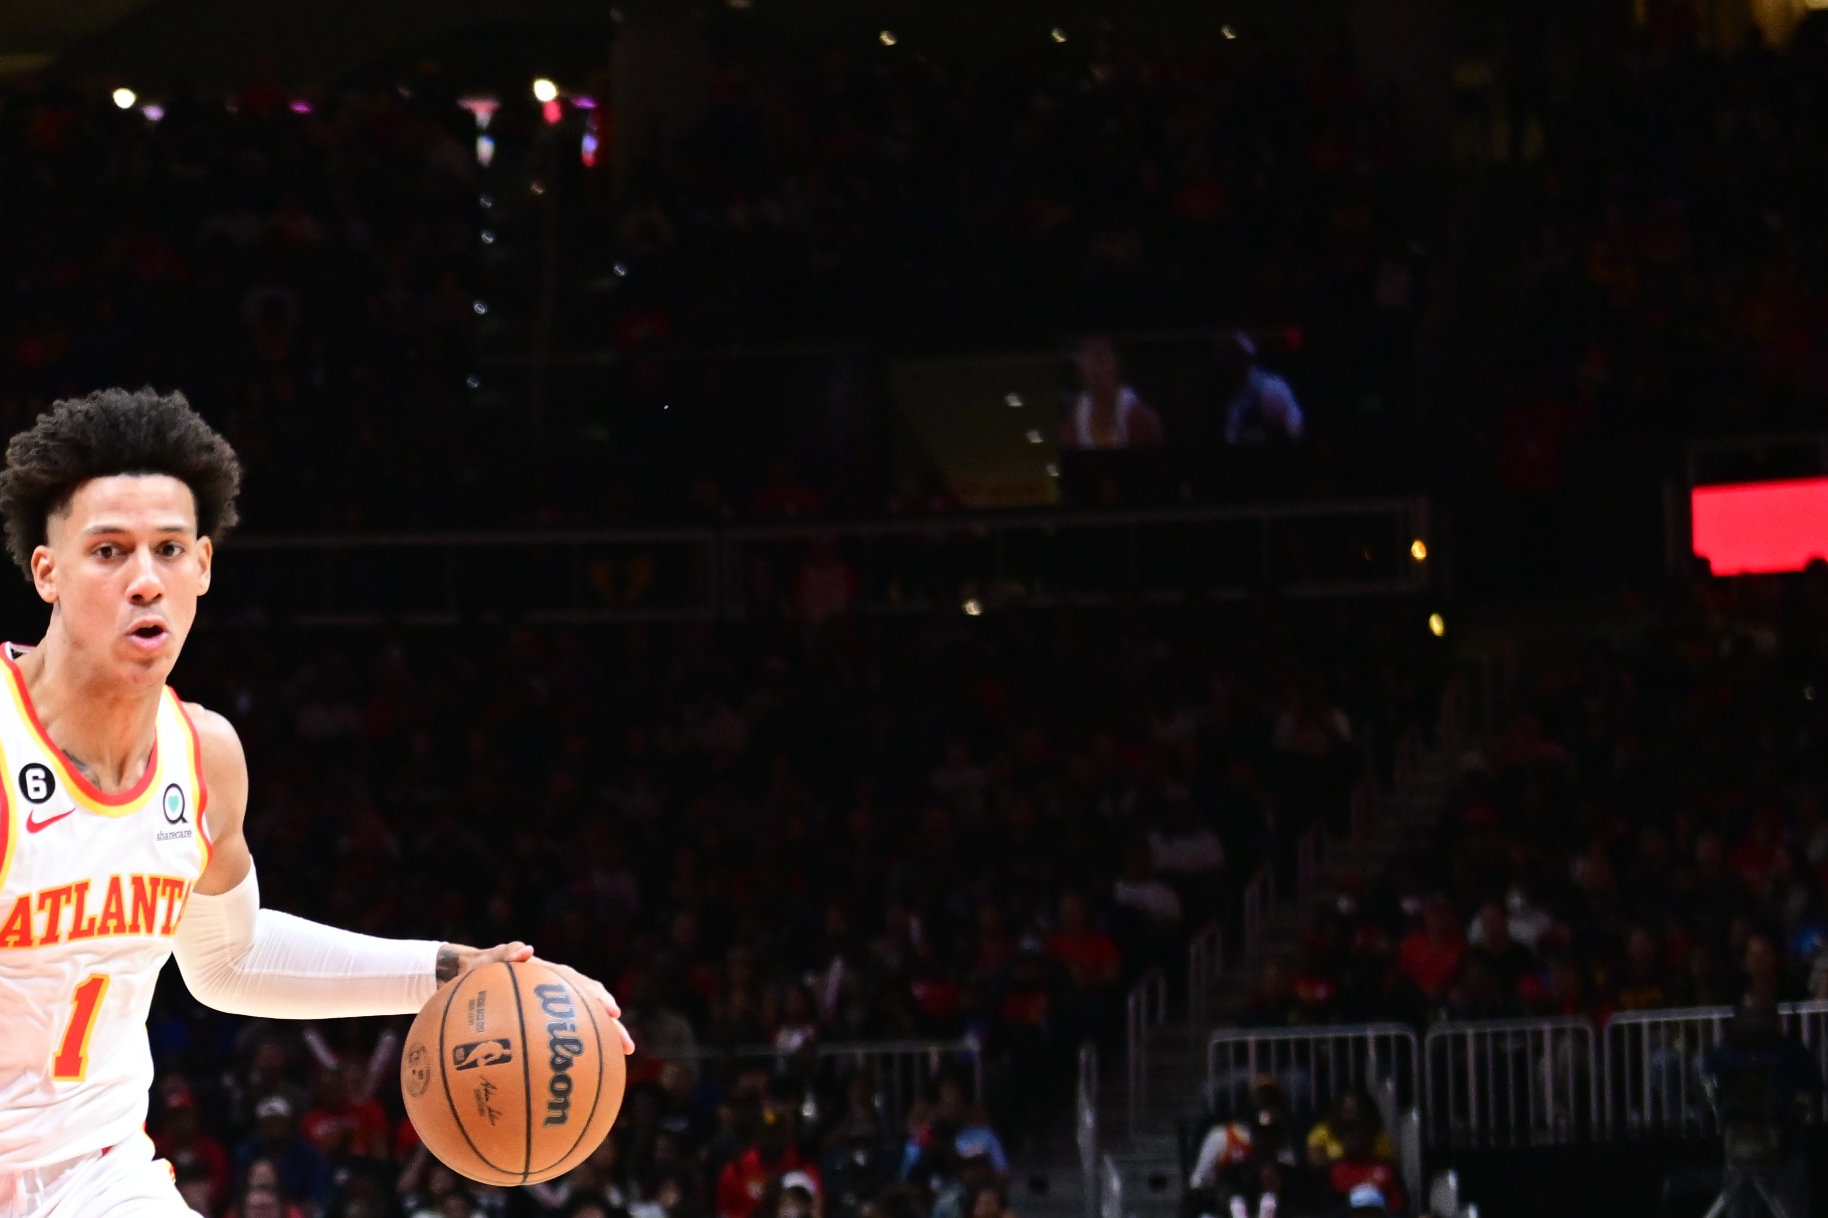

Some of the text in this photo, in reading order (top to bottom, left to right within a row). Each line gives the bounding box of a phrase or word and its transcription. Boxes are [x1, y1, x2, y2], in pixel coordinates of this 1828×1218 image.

[25, 767, 47, 800] 6
[156, 830, 192, 841] sharecare
[50, 973, 110, 1082] 1
[533, 982, 584, 1128] Wilson
